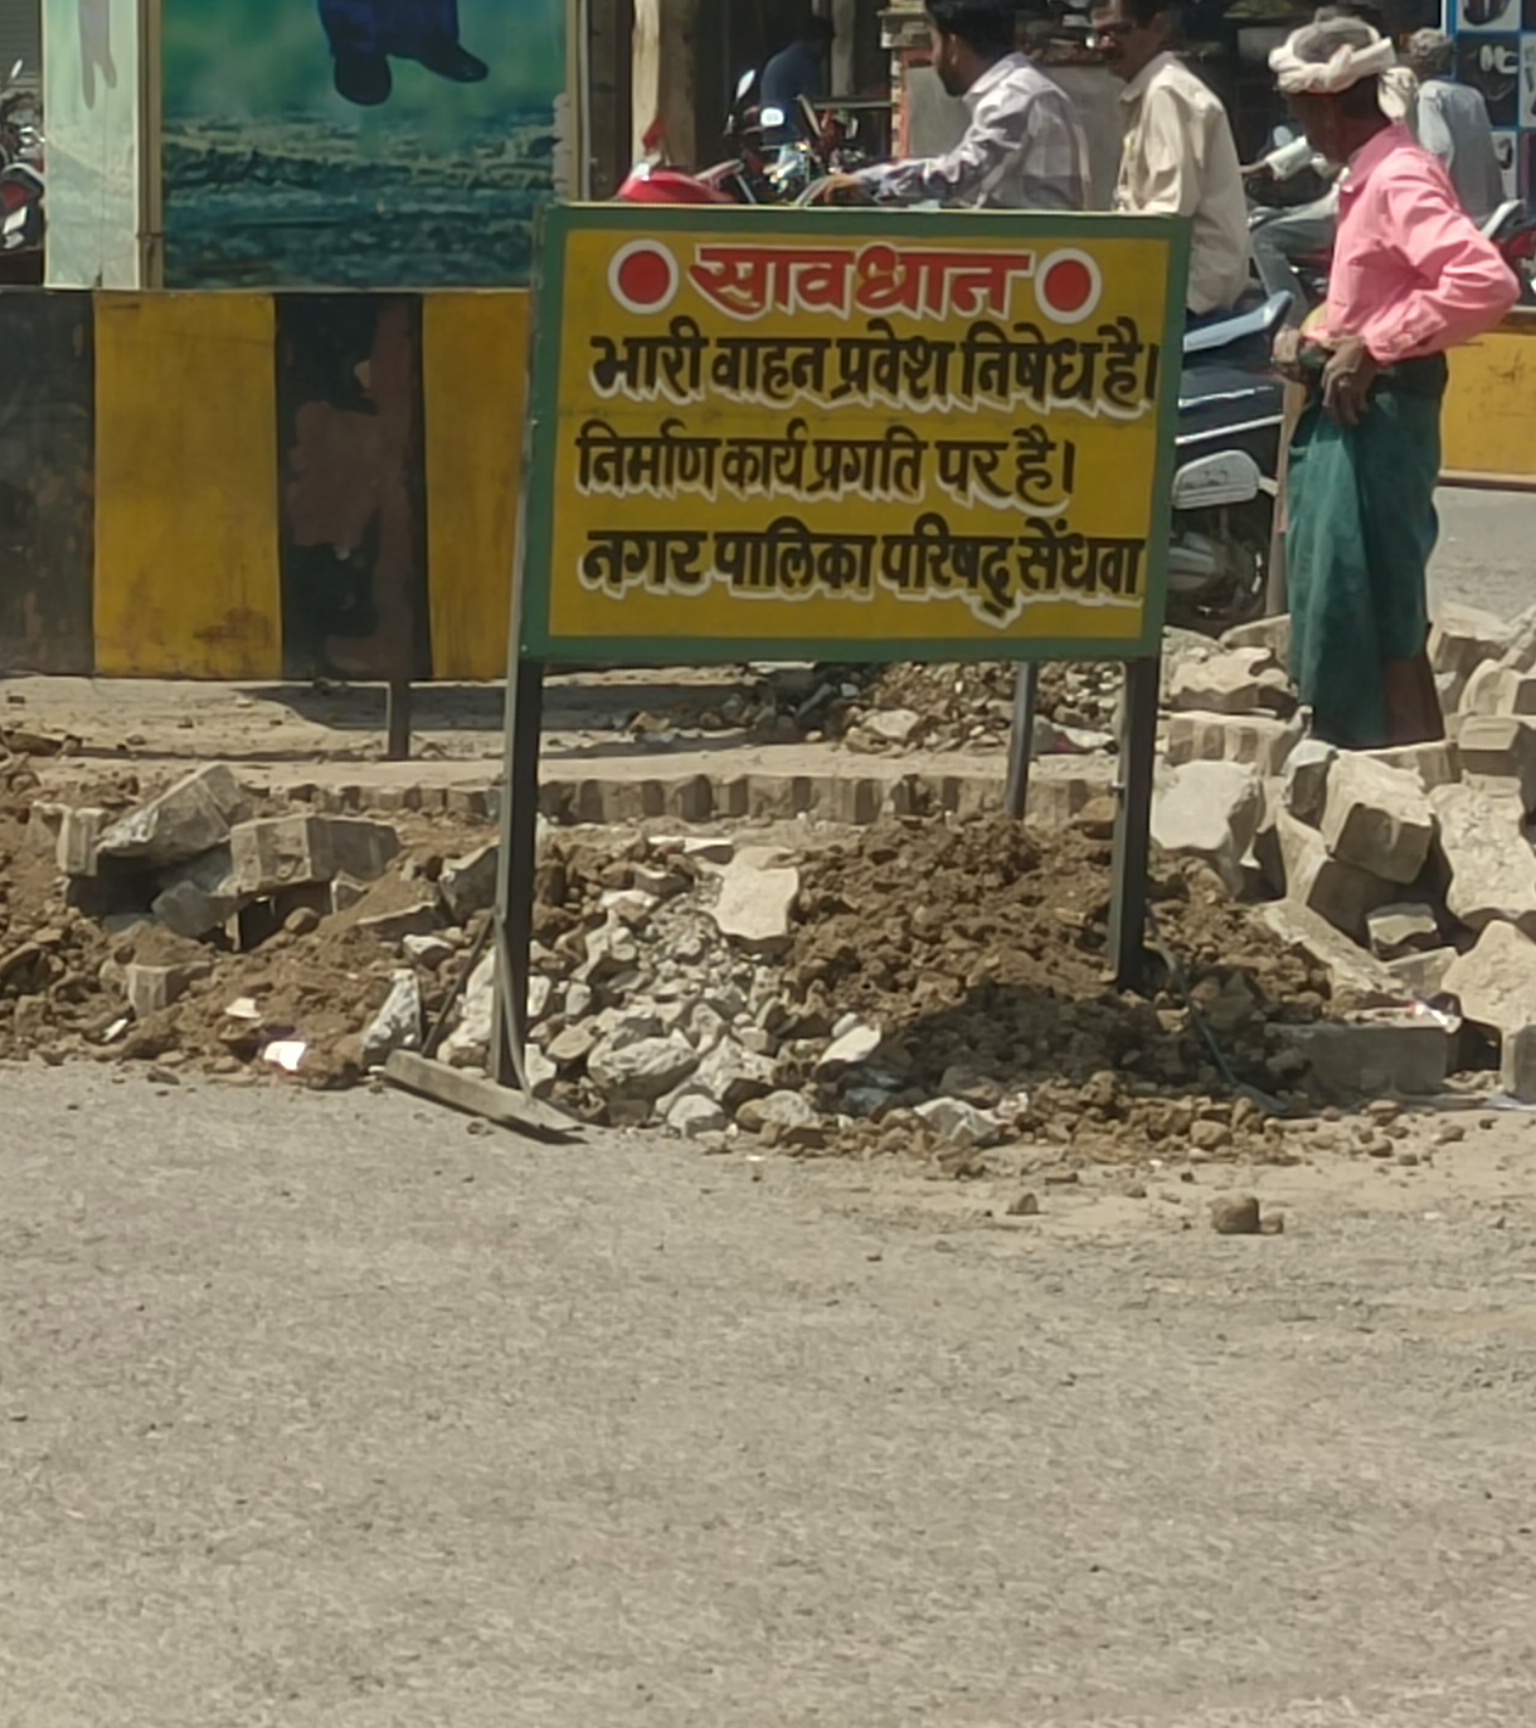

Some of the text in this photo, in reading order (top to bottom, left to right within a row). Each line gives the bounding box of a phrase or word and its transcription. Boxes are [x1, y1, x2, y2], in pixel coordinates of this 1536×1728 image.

[686, 241, 1037, 322] सावधान
[590, 316, 708, 402] भारी
[711, 336, 830, 405] वाहन
[832, 318, 954, 406] प्रवेश
[960, 322, 1098, 409] निषेध
[575, 420, 721, 495] निर्माण
[722, 418, 807, 495] कार्य
[810, 424, 929, 499] प्रगति
[934, 438, 1008, 504] पर
[580, 529, 709, 594] नगर
[714, 516, 876, 596] पालिका
[1017, 517, 1146, 602] सेंधवा
